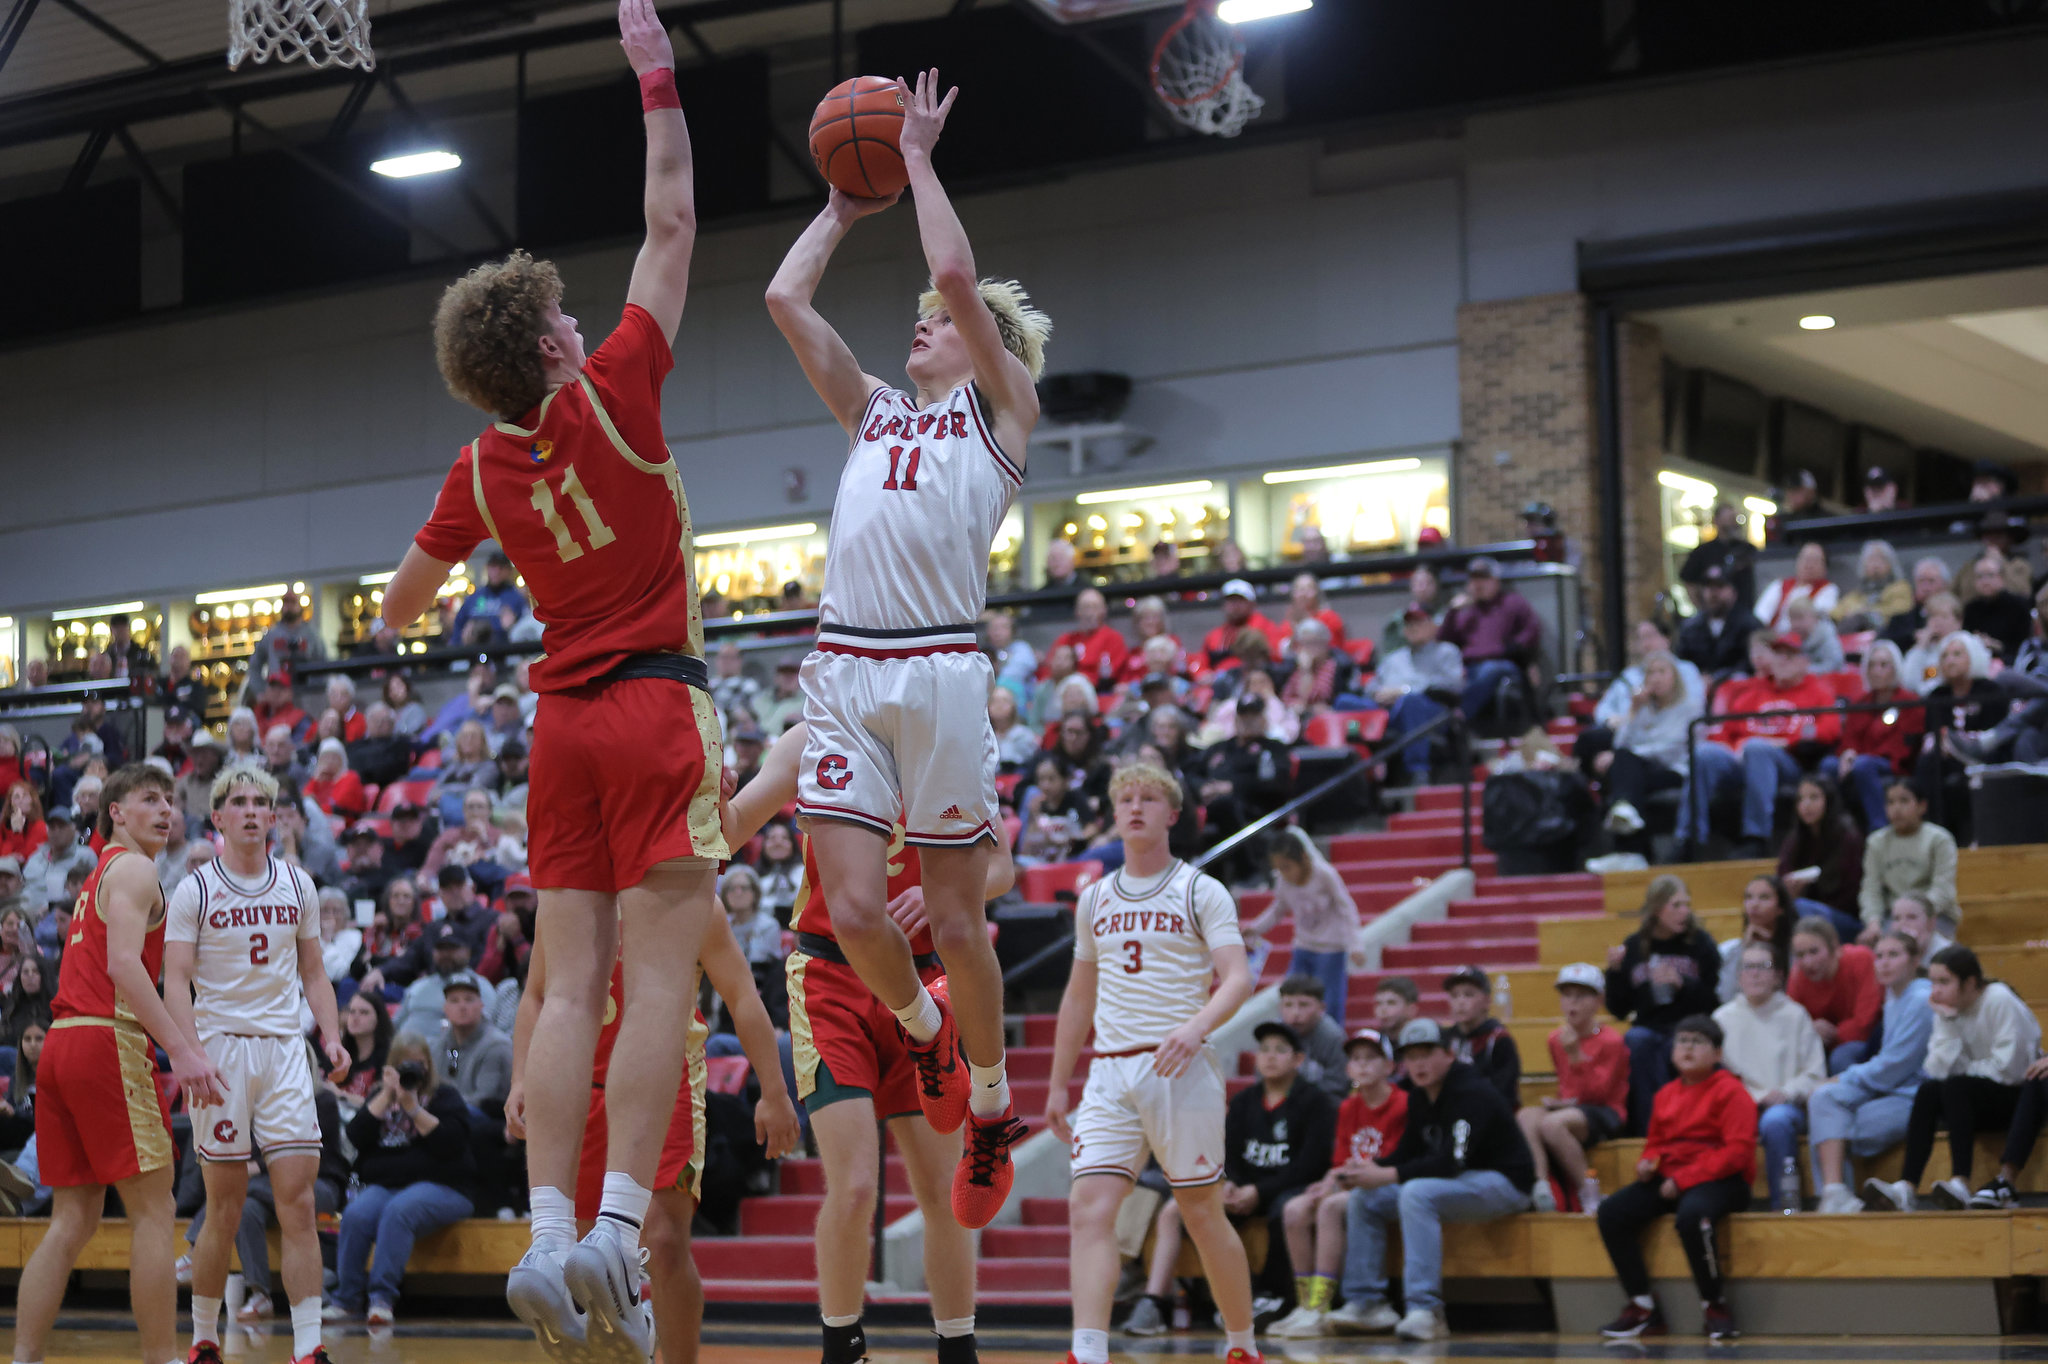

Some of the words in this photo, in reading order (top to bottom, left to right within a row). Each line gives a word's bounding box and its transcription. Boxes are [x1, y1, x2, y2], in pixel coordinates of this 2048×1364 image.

[864, 409, 968, 442] GRUVER
[883, 446, 921, 490] 11
[530, 462, 616, 564] 11
[209, 905, 299, 929] GRUVER
[1094, 911, 1185, 937] GRUVER
[249, 933, 269, 965] 2
[1123, 940, 1142, 974] 3
